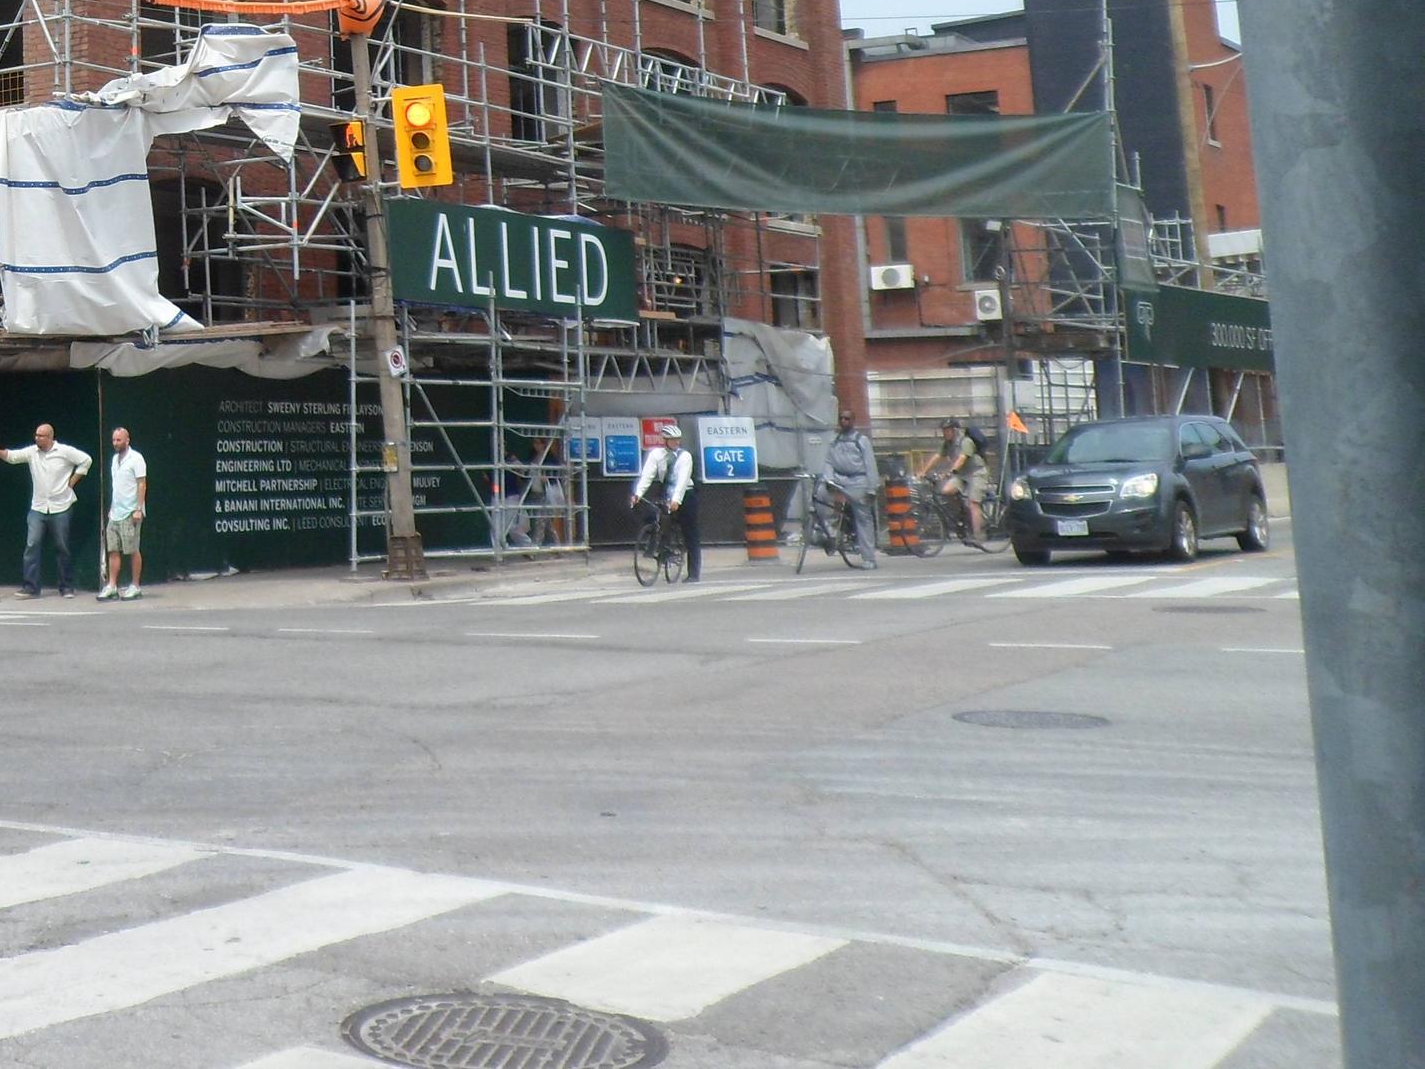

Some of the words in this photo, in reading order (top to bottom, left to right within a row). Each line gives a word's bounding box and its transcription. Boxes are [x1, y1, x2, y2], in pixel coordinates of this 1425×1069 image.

[430, 213, 609, 306] ALLIED
[268, 401, 301, 414] SWEENY
[303, 402, 340, 415] STERLING
[707, 426, 748, 435] EASTERN
[216, 440, 283, 453] CONSTRUCTION
[714, 450, 745, 462] GATE
[216, 460, 274, 472] ENGINEERING
[276, 460, 292, 472] LTD
[726, 464, 734, 476] 2
[215, 480, 258, 492] MITCHELL
[260, 479, 318, 492] PARTNERSHIP
[215, 500, 222, 513] &
[224, 500, 258, 512] BANANI
[260, 497, 327, 512] INTERNATIONAL
[329, 497, 346, 510] INC.
[215, 518, 270, 533] CONSULTING
[272, 518, 291, 532] INC.
